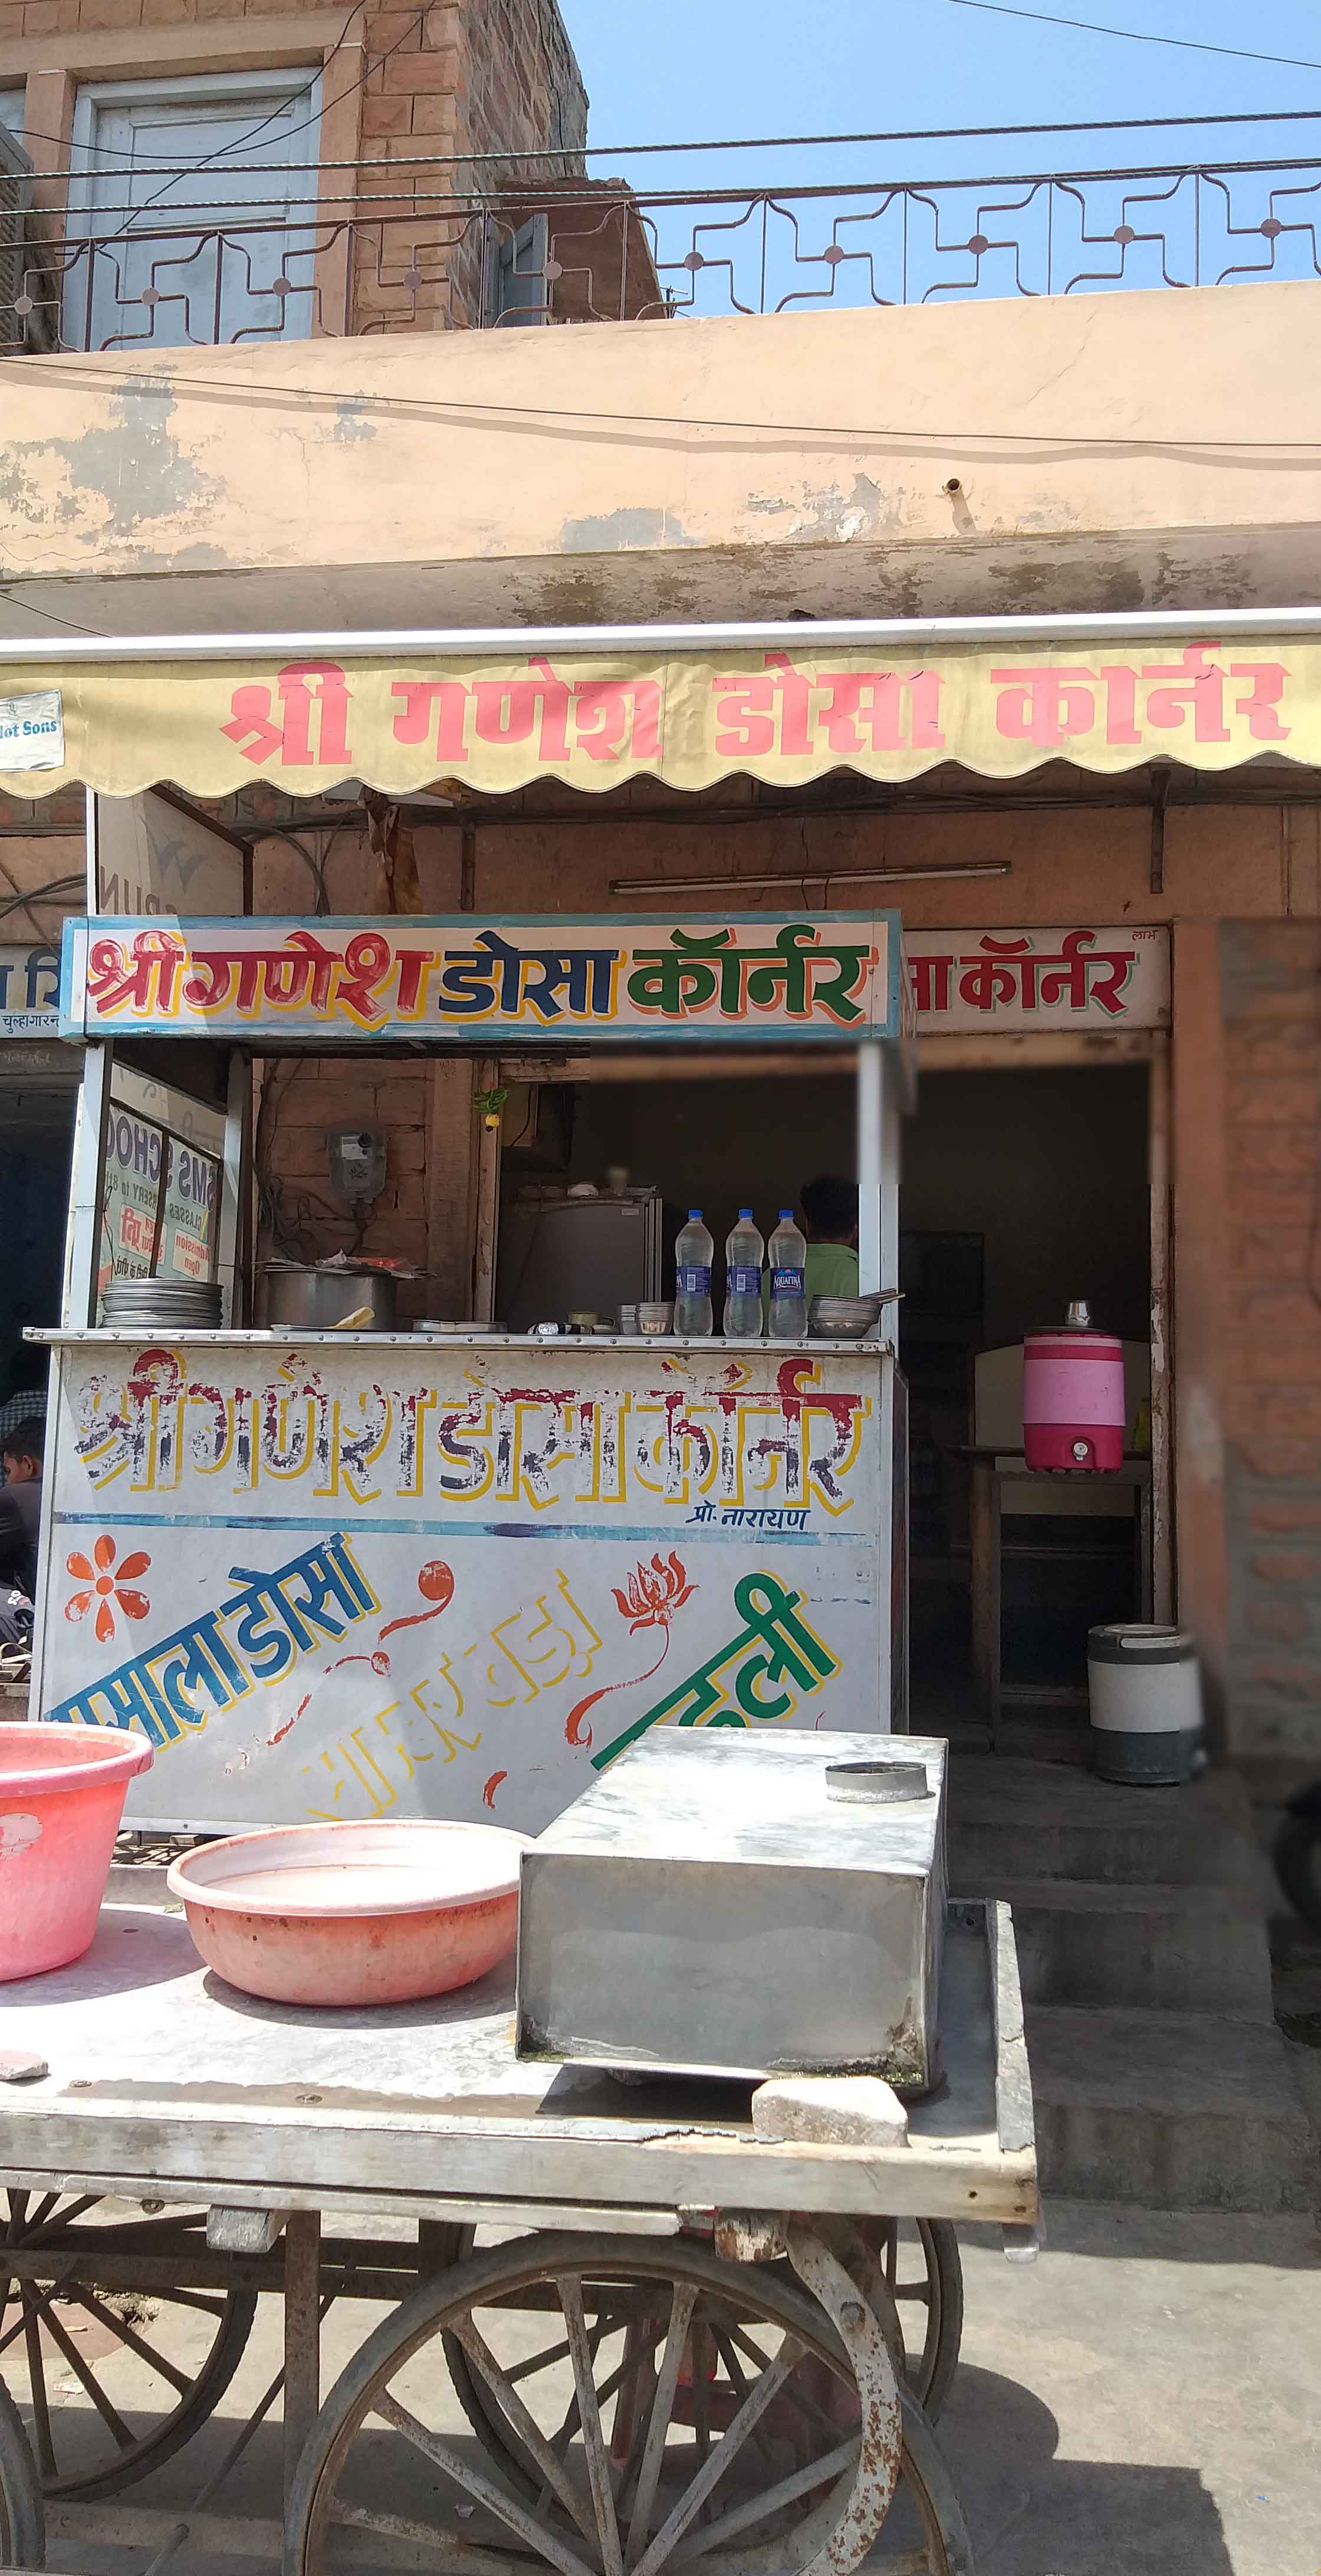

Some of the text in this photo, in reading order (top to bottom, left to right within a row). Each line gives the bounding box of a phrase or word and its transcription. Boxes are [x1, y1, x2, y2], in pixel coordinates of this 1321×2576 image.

[219, 640, 1293, 766] श्री गणेश डोसा कार्नर
[23, 720, 57, 735] Sons
[1132, 929, 1160, 942] लाभ
[87, 931, 185, 1017] श्री
[183, 931, 440, 1032] गणेश
[438, 929, 627, 1026] डोसा
[773, 1274, 801, 1287] AQUAFINA
[721, 1508, 811, 1530] नारायण
